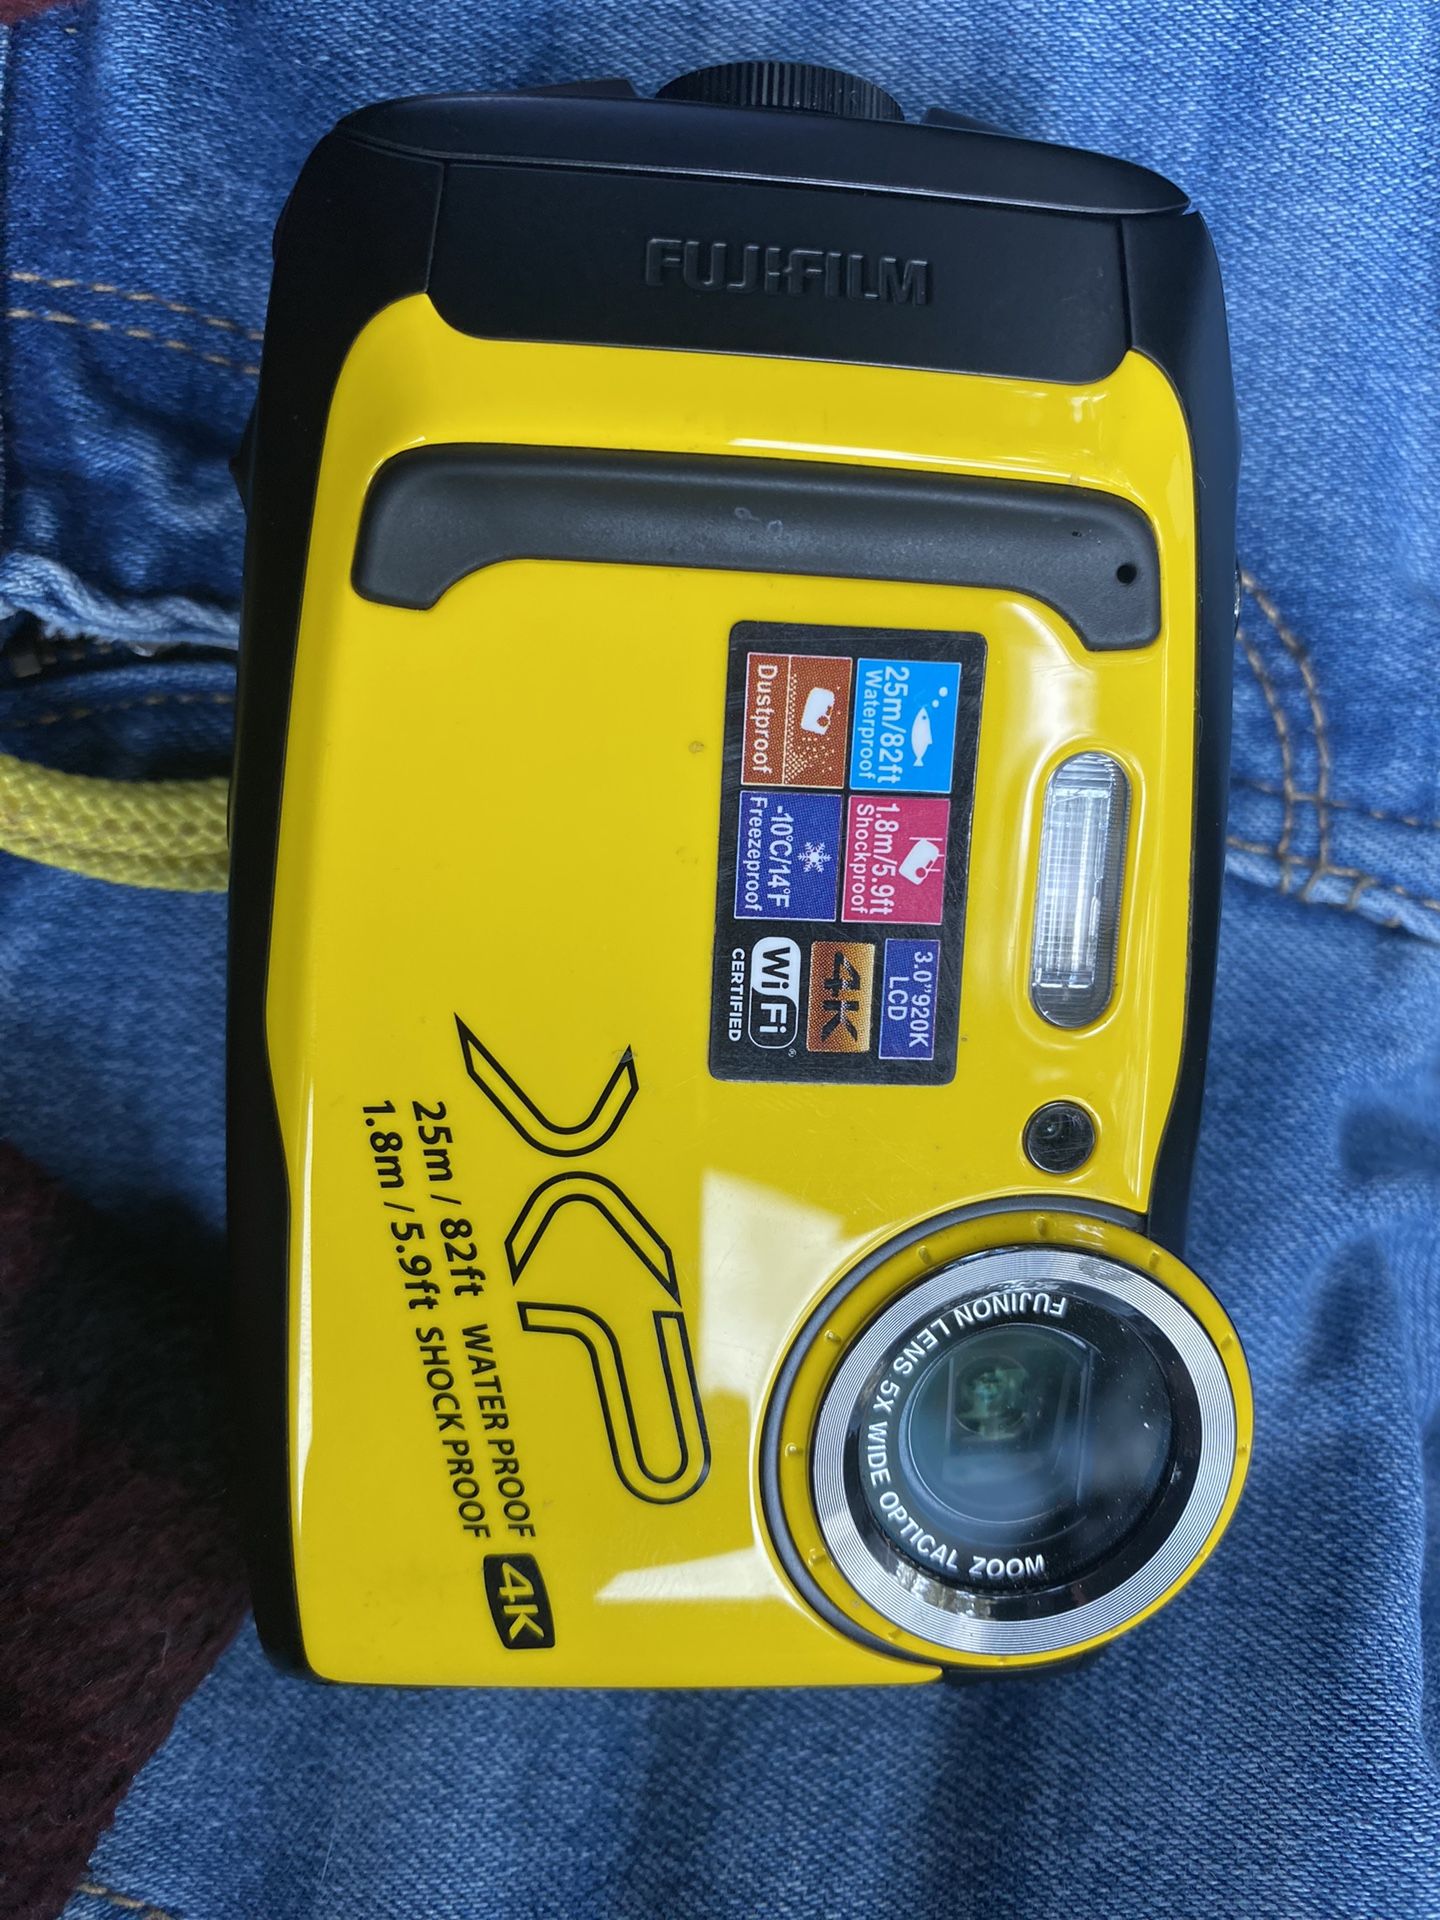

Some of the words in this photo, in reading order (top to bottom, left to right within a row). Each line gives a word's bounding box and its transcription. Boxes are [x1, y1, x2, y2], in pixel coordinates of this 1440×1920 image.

[646, 237, 931, 305] FUJIFILM
[751, 664, 778, 774] Dustproof
[857, 669, 883, 780] Waterproof
[877, 666, 910, 785] 25m/82ft
[743, 796, 768, 912] Freezeproof
[767, 805, 794, 908] -10°C/14°F
[849, 803, 873, 914] Shockproof
[869, 803, 900, 916] 1.8m/5.9ft
[728, 947, 745, 1042] CERTIFIED
[821, 951, 860, 1041] 4K
[888, 975, 909, 1021] LCD
[411, 1100, 454, 1182] 25m
[440, 1216, 486, 1297] 82ft
[363, 1101, 405, 1188] 1.8m
[391, 1221, 439, 1310] 5.9ft
[416, 1326, 465, 1432] SHOCK
[442, 1437, 492, 1539] PROOF
[893, 1318, 950, 1376] LENS
[954, 1292, 1068, 1330] FUJINON
[462, 1323, 509, 1430] WATER
[873, 1380, 900, 1414] 5X
[485, 1437, 536, 1539] PROOF
[867, 1420, 891, 1487] WIDE
[880, 1491, 958, 1570] OPTICAL
[969, 1553, 1047, 1579] ZOOM
[497, 1562, 545, 1643] 4K
